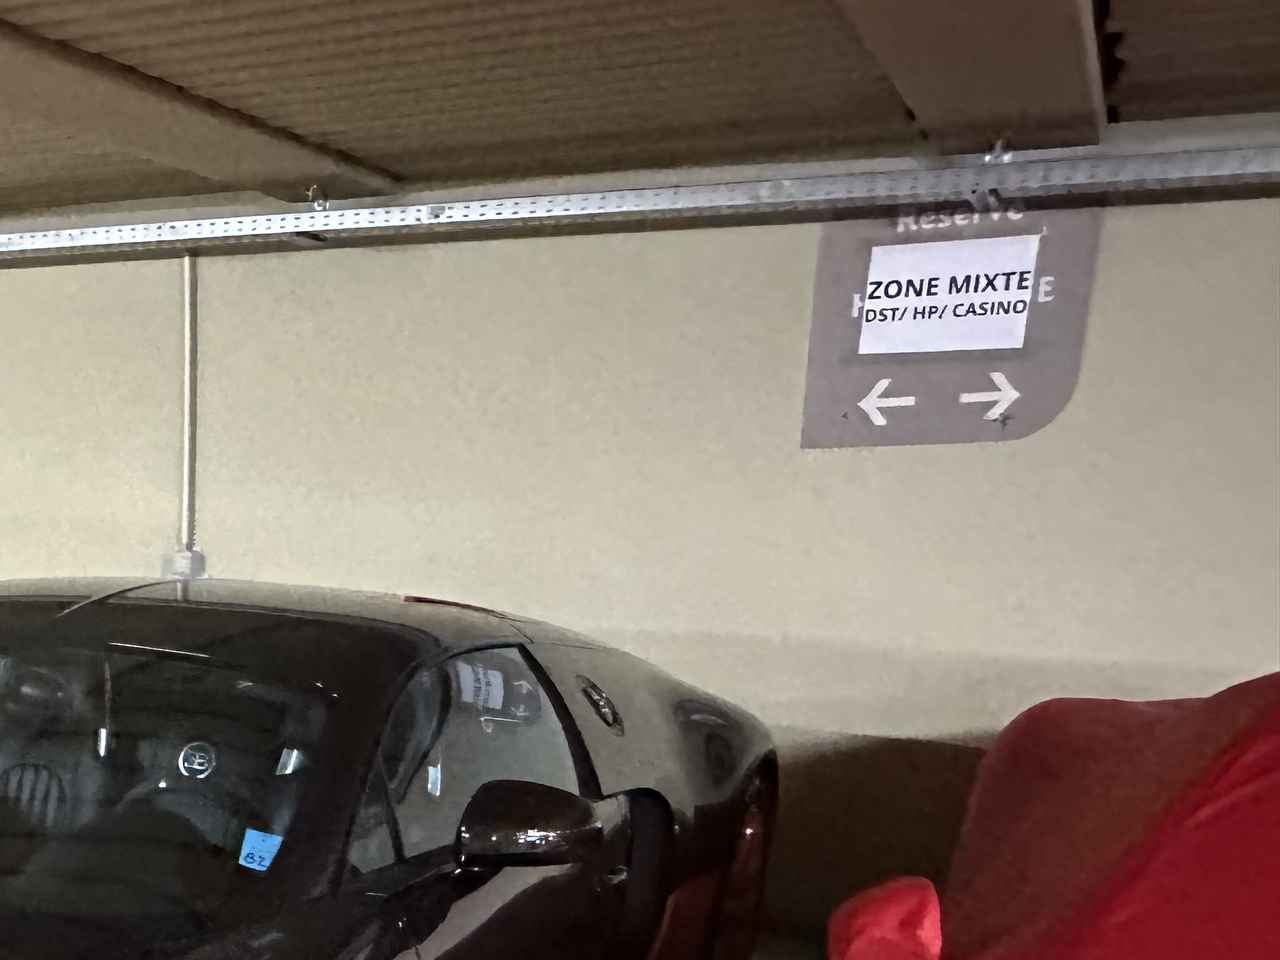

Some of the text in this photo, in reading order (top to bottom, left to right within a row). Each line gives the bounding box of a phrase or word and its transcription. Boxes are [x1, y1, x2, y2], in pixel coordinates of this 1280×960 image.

[867, 270, 1032, 300] ZONE MIXTE
[865, 299, 1028, 323] DST/ HP/ CASINO
